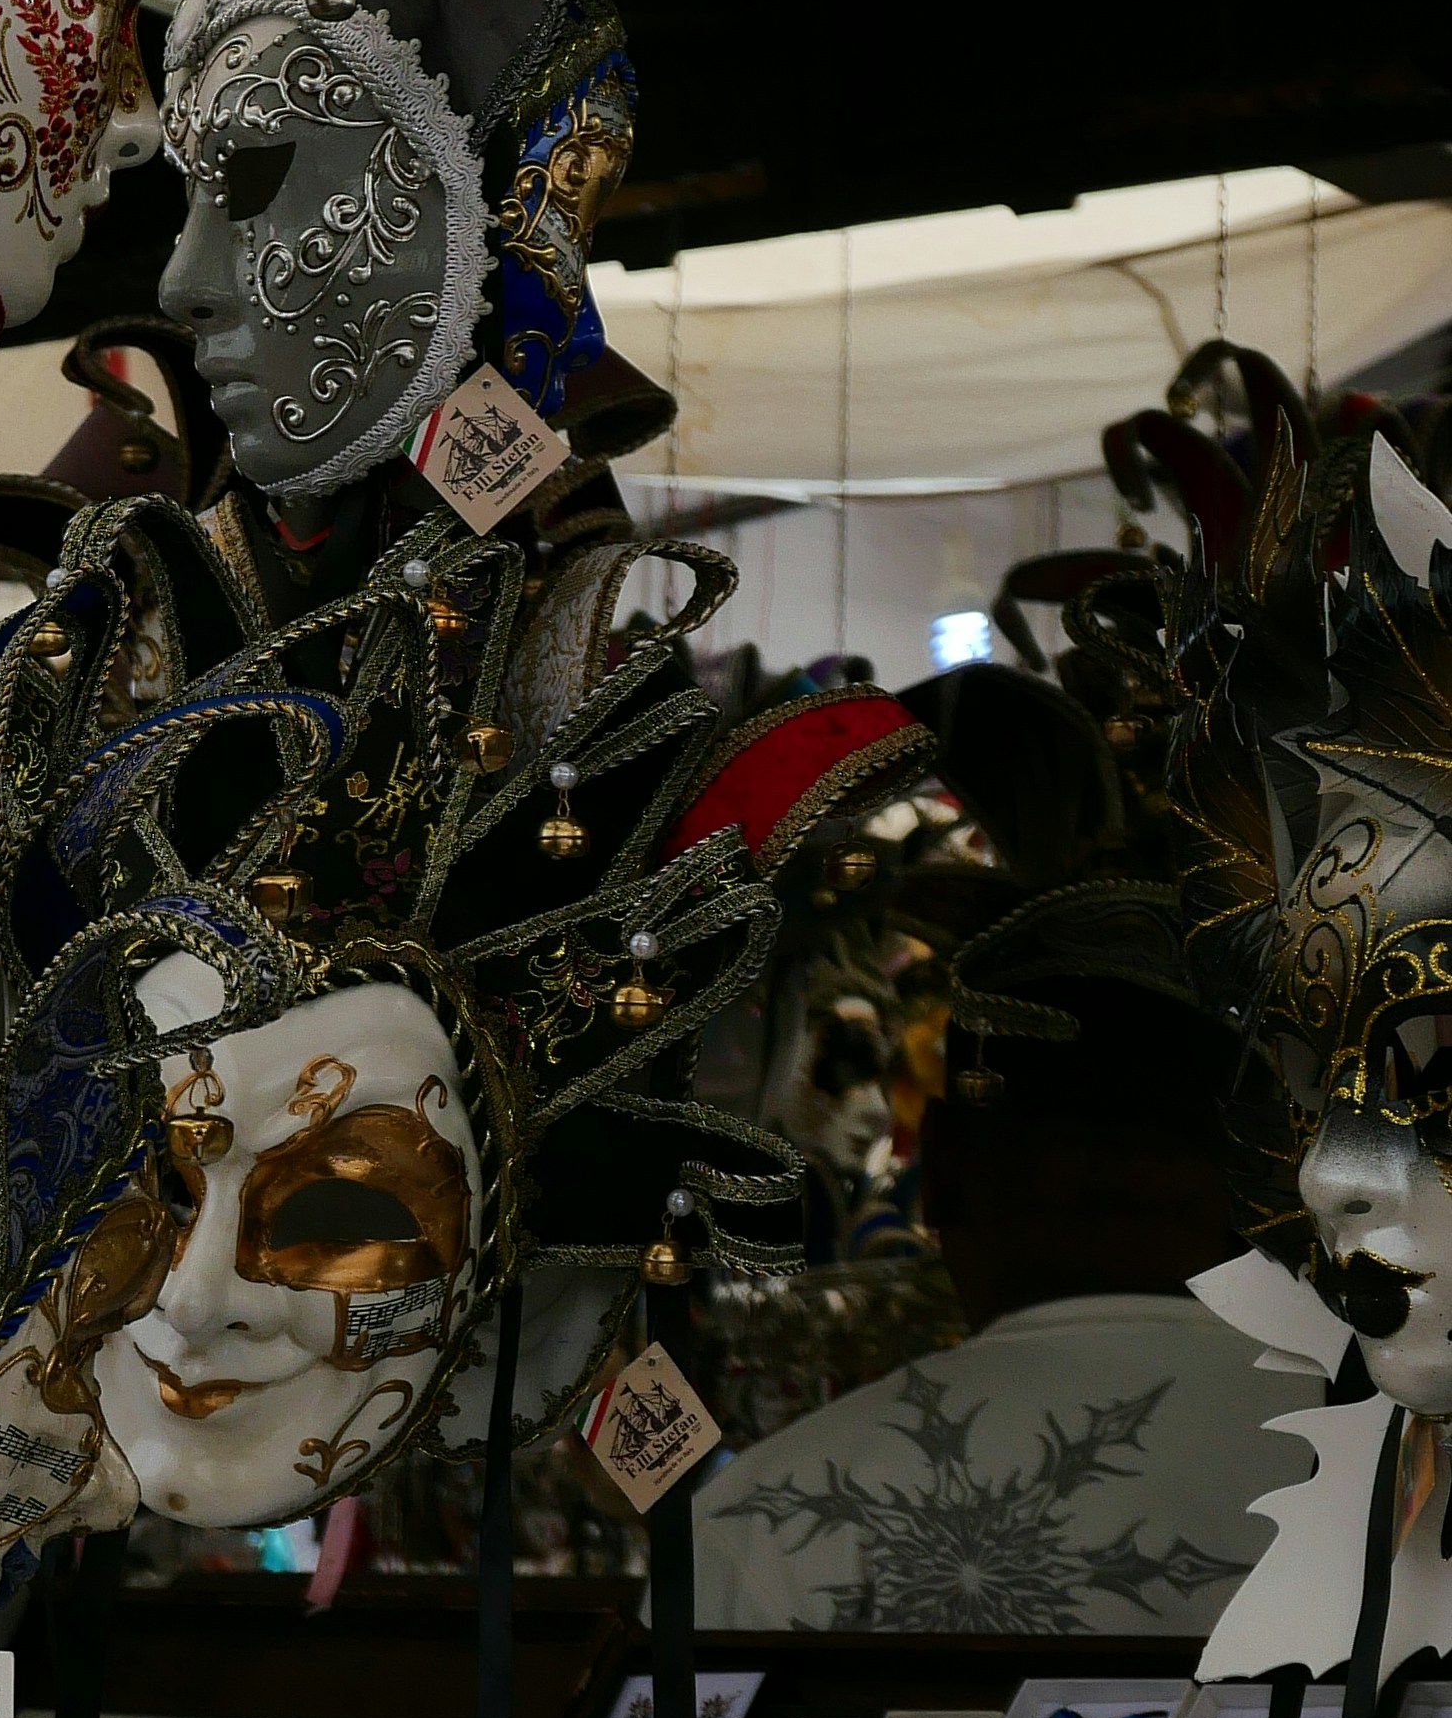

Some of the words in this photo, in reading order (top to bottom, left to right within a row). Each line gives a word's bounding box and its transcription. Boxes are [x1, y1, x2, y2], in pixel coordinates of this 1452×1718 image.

[461, 470, 493, 501] F.lli
[490, 431, 540, 476] Stefan
[624, 1449, 654, 1479] F.lli
[650, 1412, 698, 1454] Stefan
